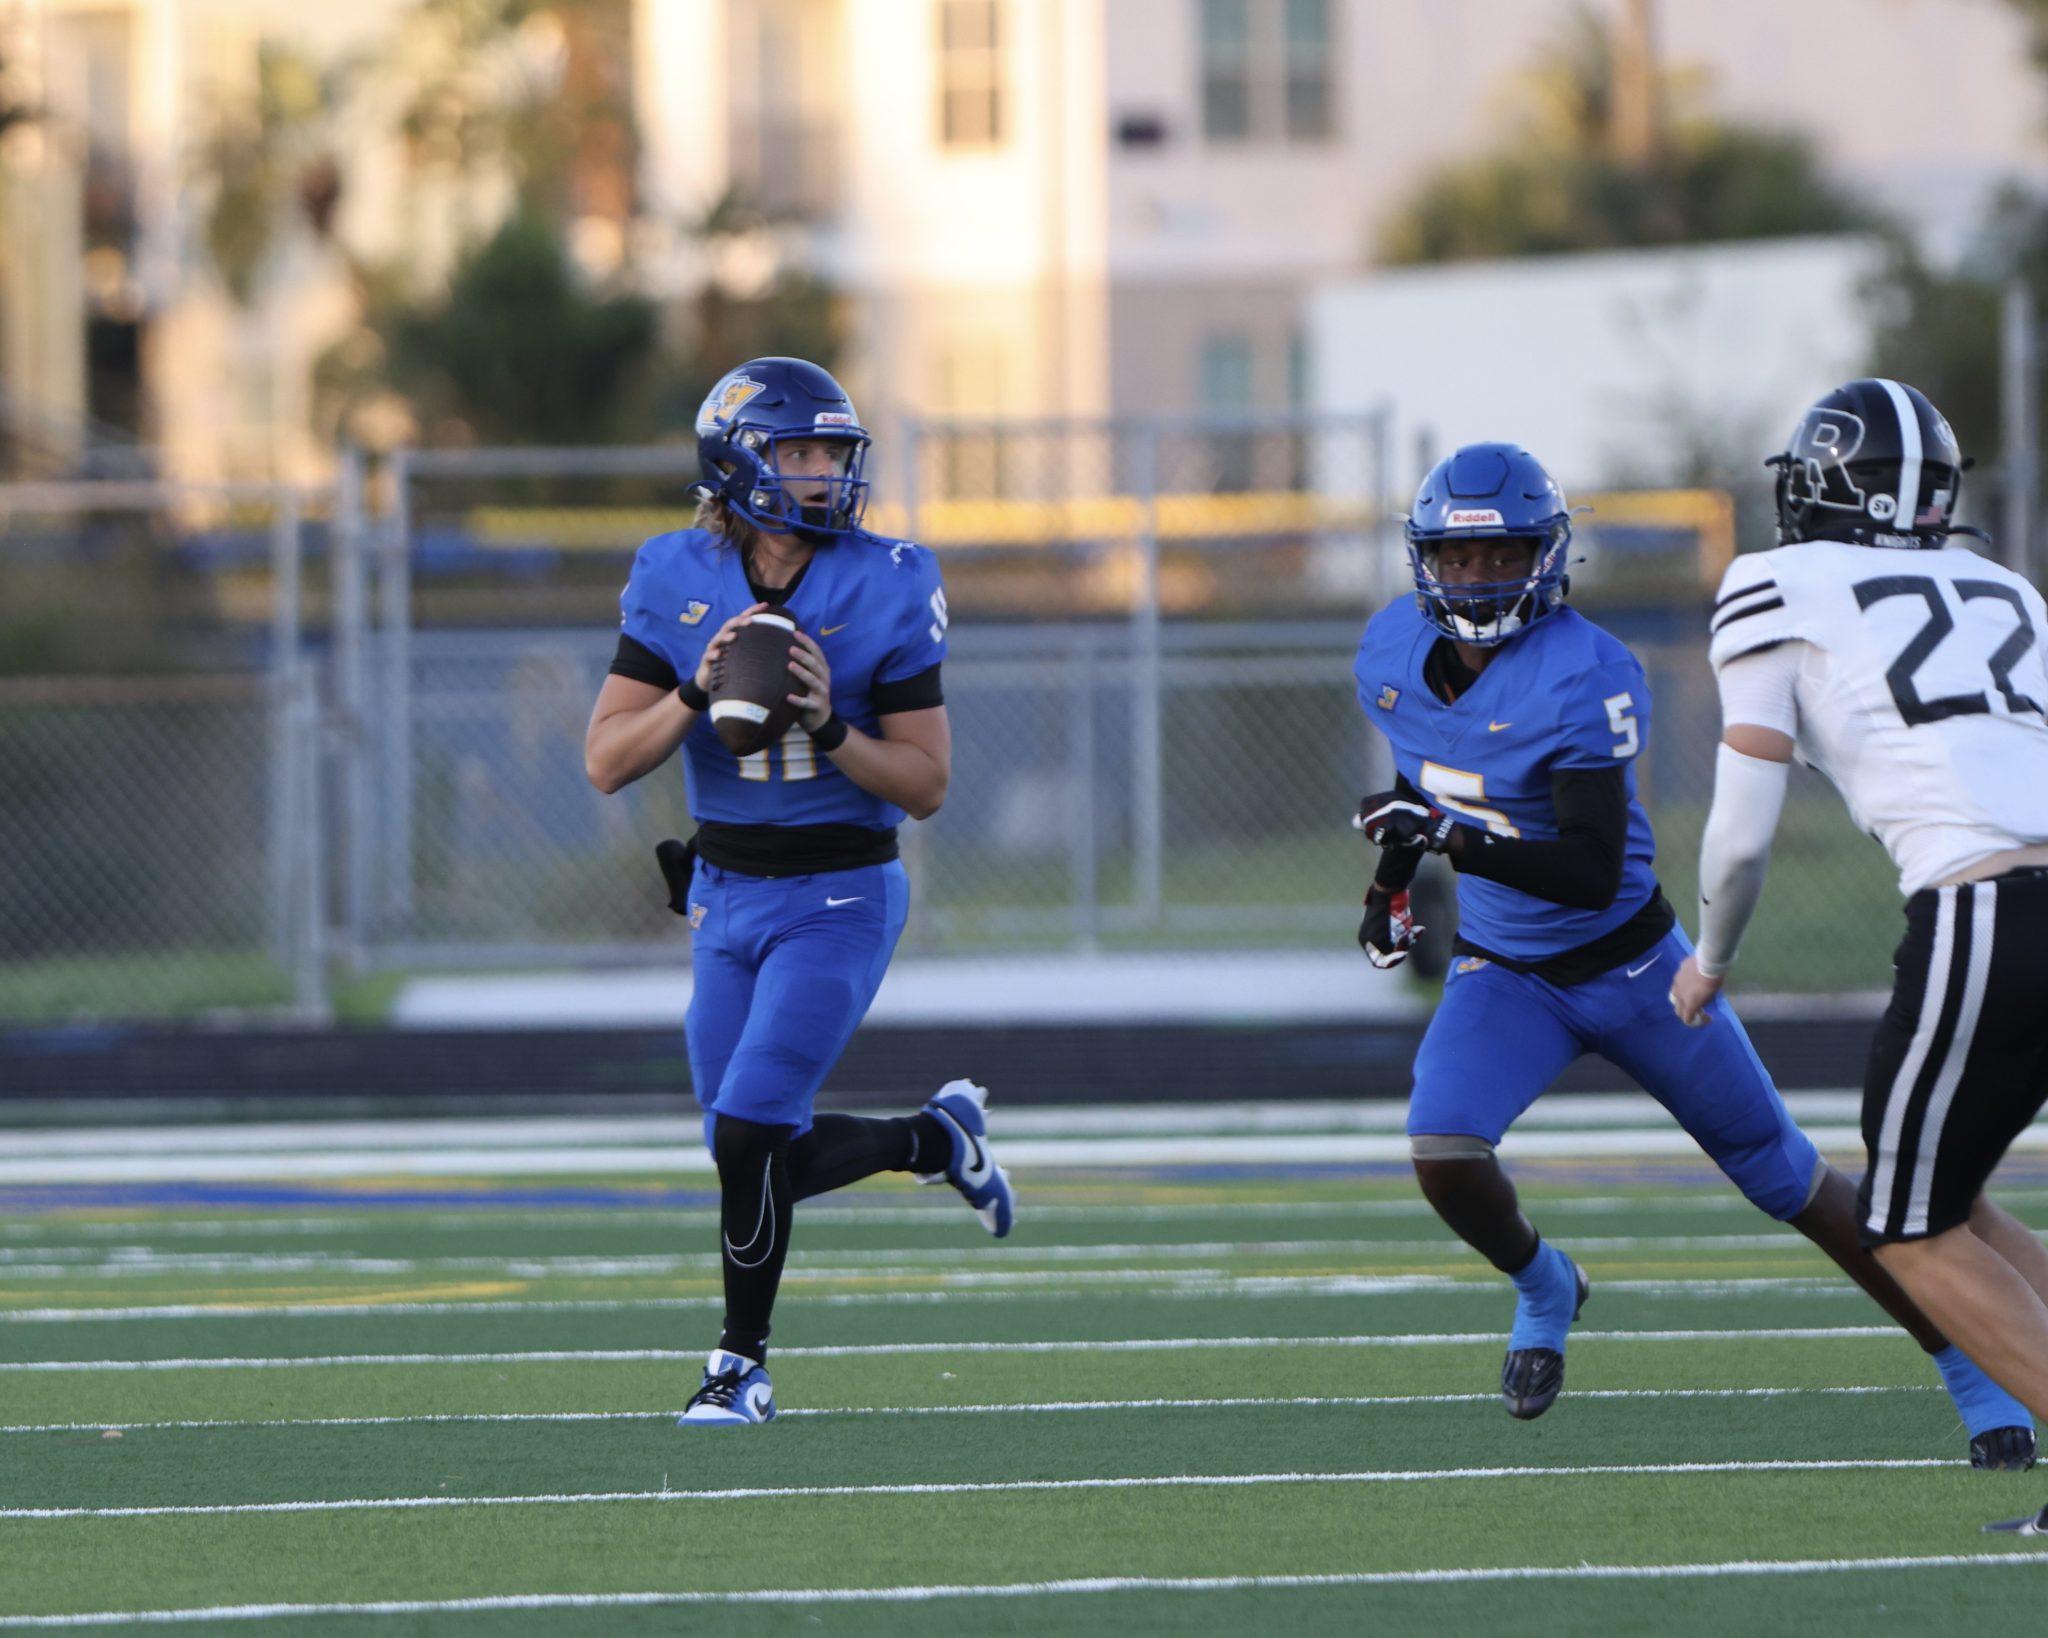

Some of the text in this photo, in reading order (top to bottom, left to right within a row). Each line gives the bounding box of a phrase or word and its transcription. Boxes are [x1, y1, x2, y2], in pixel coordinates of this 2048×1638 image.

[1786, 406, 1866, 511] R
[1452, 512, 1496, 523] Riddell
[1851, 574, 2047, 728] 22
[1603, 691, 1640, 759] 5
[1420, 761, 1521, 839] 5
